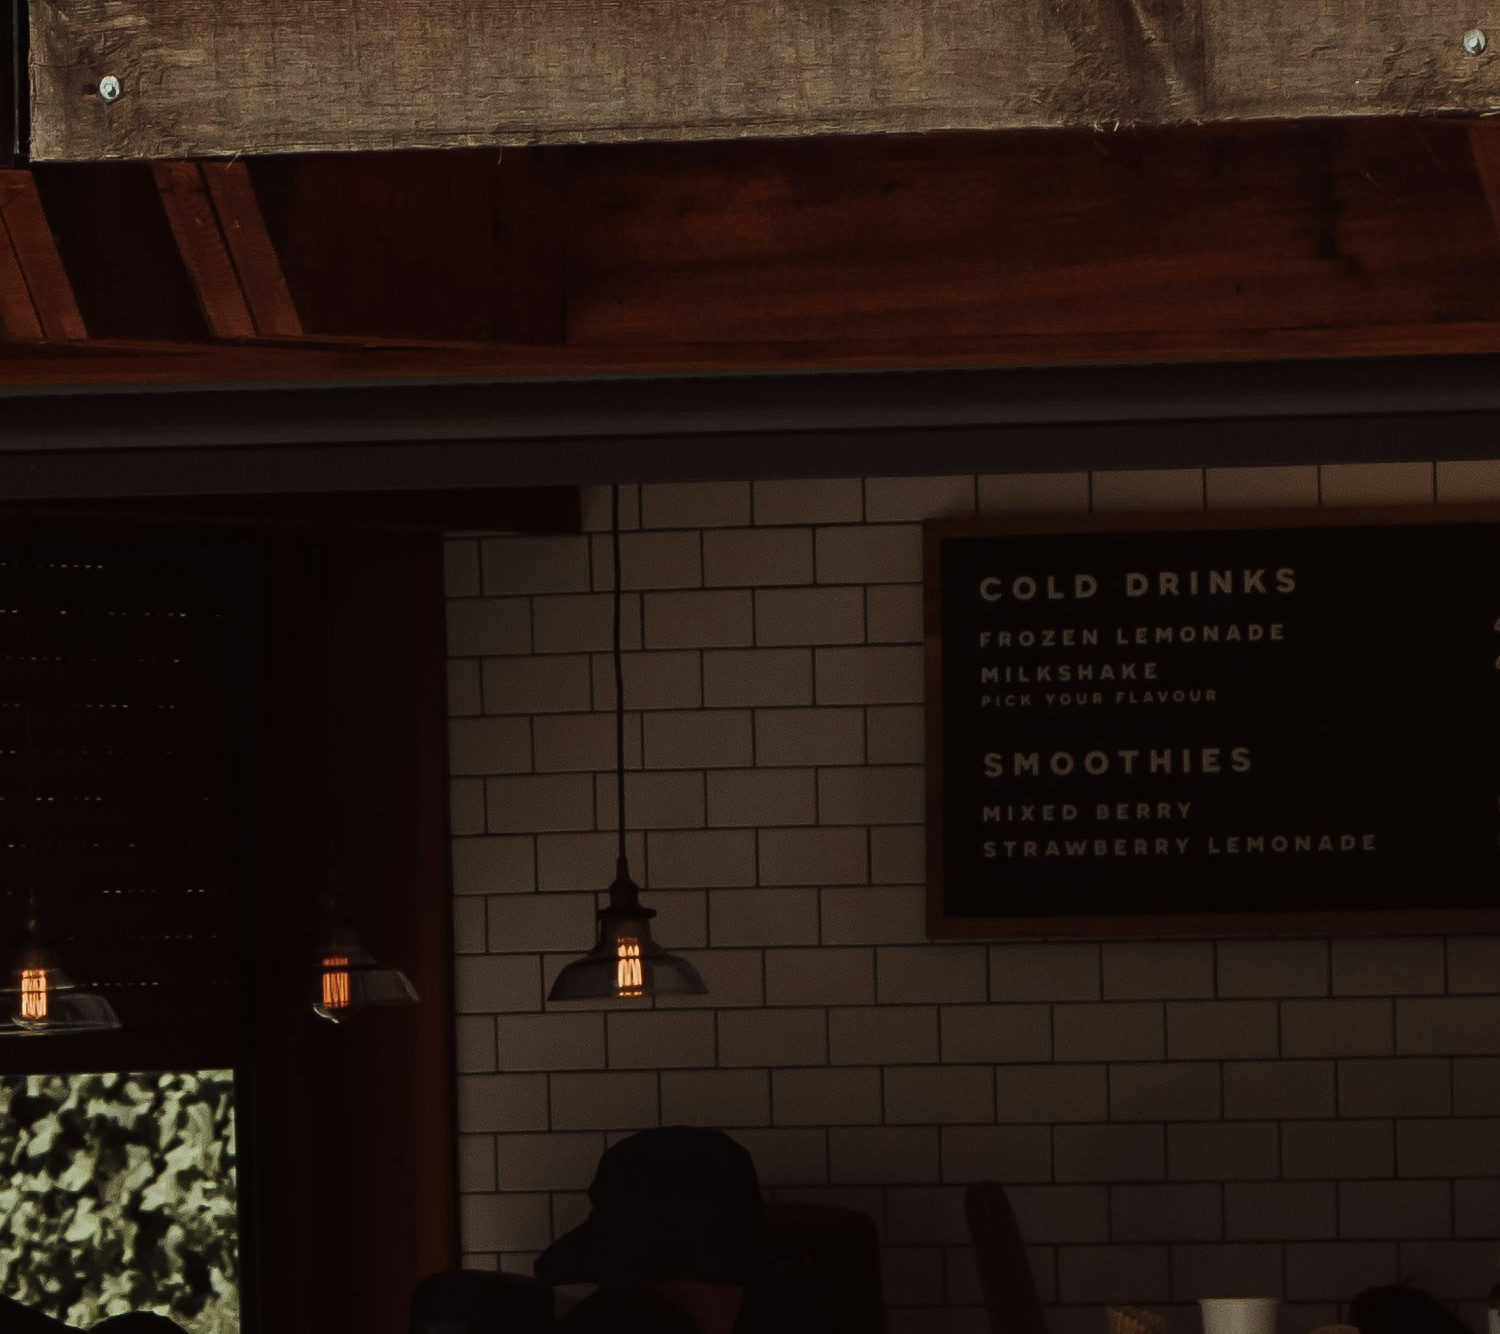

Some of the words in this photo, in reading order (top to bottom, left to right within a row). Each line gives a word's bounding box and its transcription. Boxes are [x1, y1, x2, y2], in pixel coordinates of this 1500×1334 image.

[979, 574, 1098, 602] COLD
[1126, 567, 1296, 597] DRINKS
[979, 629, 1098, 648] FROZEN
[1116, 623, 1284, 645] LEMONADE
[981, 662, 1157, 683] MILKSHAKE
[980, 694, 1031, 707] PICK
[1045, 691, 1103, 706] YOUR
[1115, 688, 1217, 704] FLAVOUR
[984, 746, 1251, 778] SMOOTHIES
[982, 804, 1078, 822] MIXED
[1096, 802, 1191, 821] BERRY
[983, 837, 1189, 858] STRAWBERRY
[1208, 833, 1376, 854] LEMONADE
